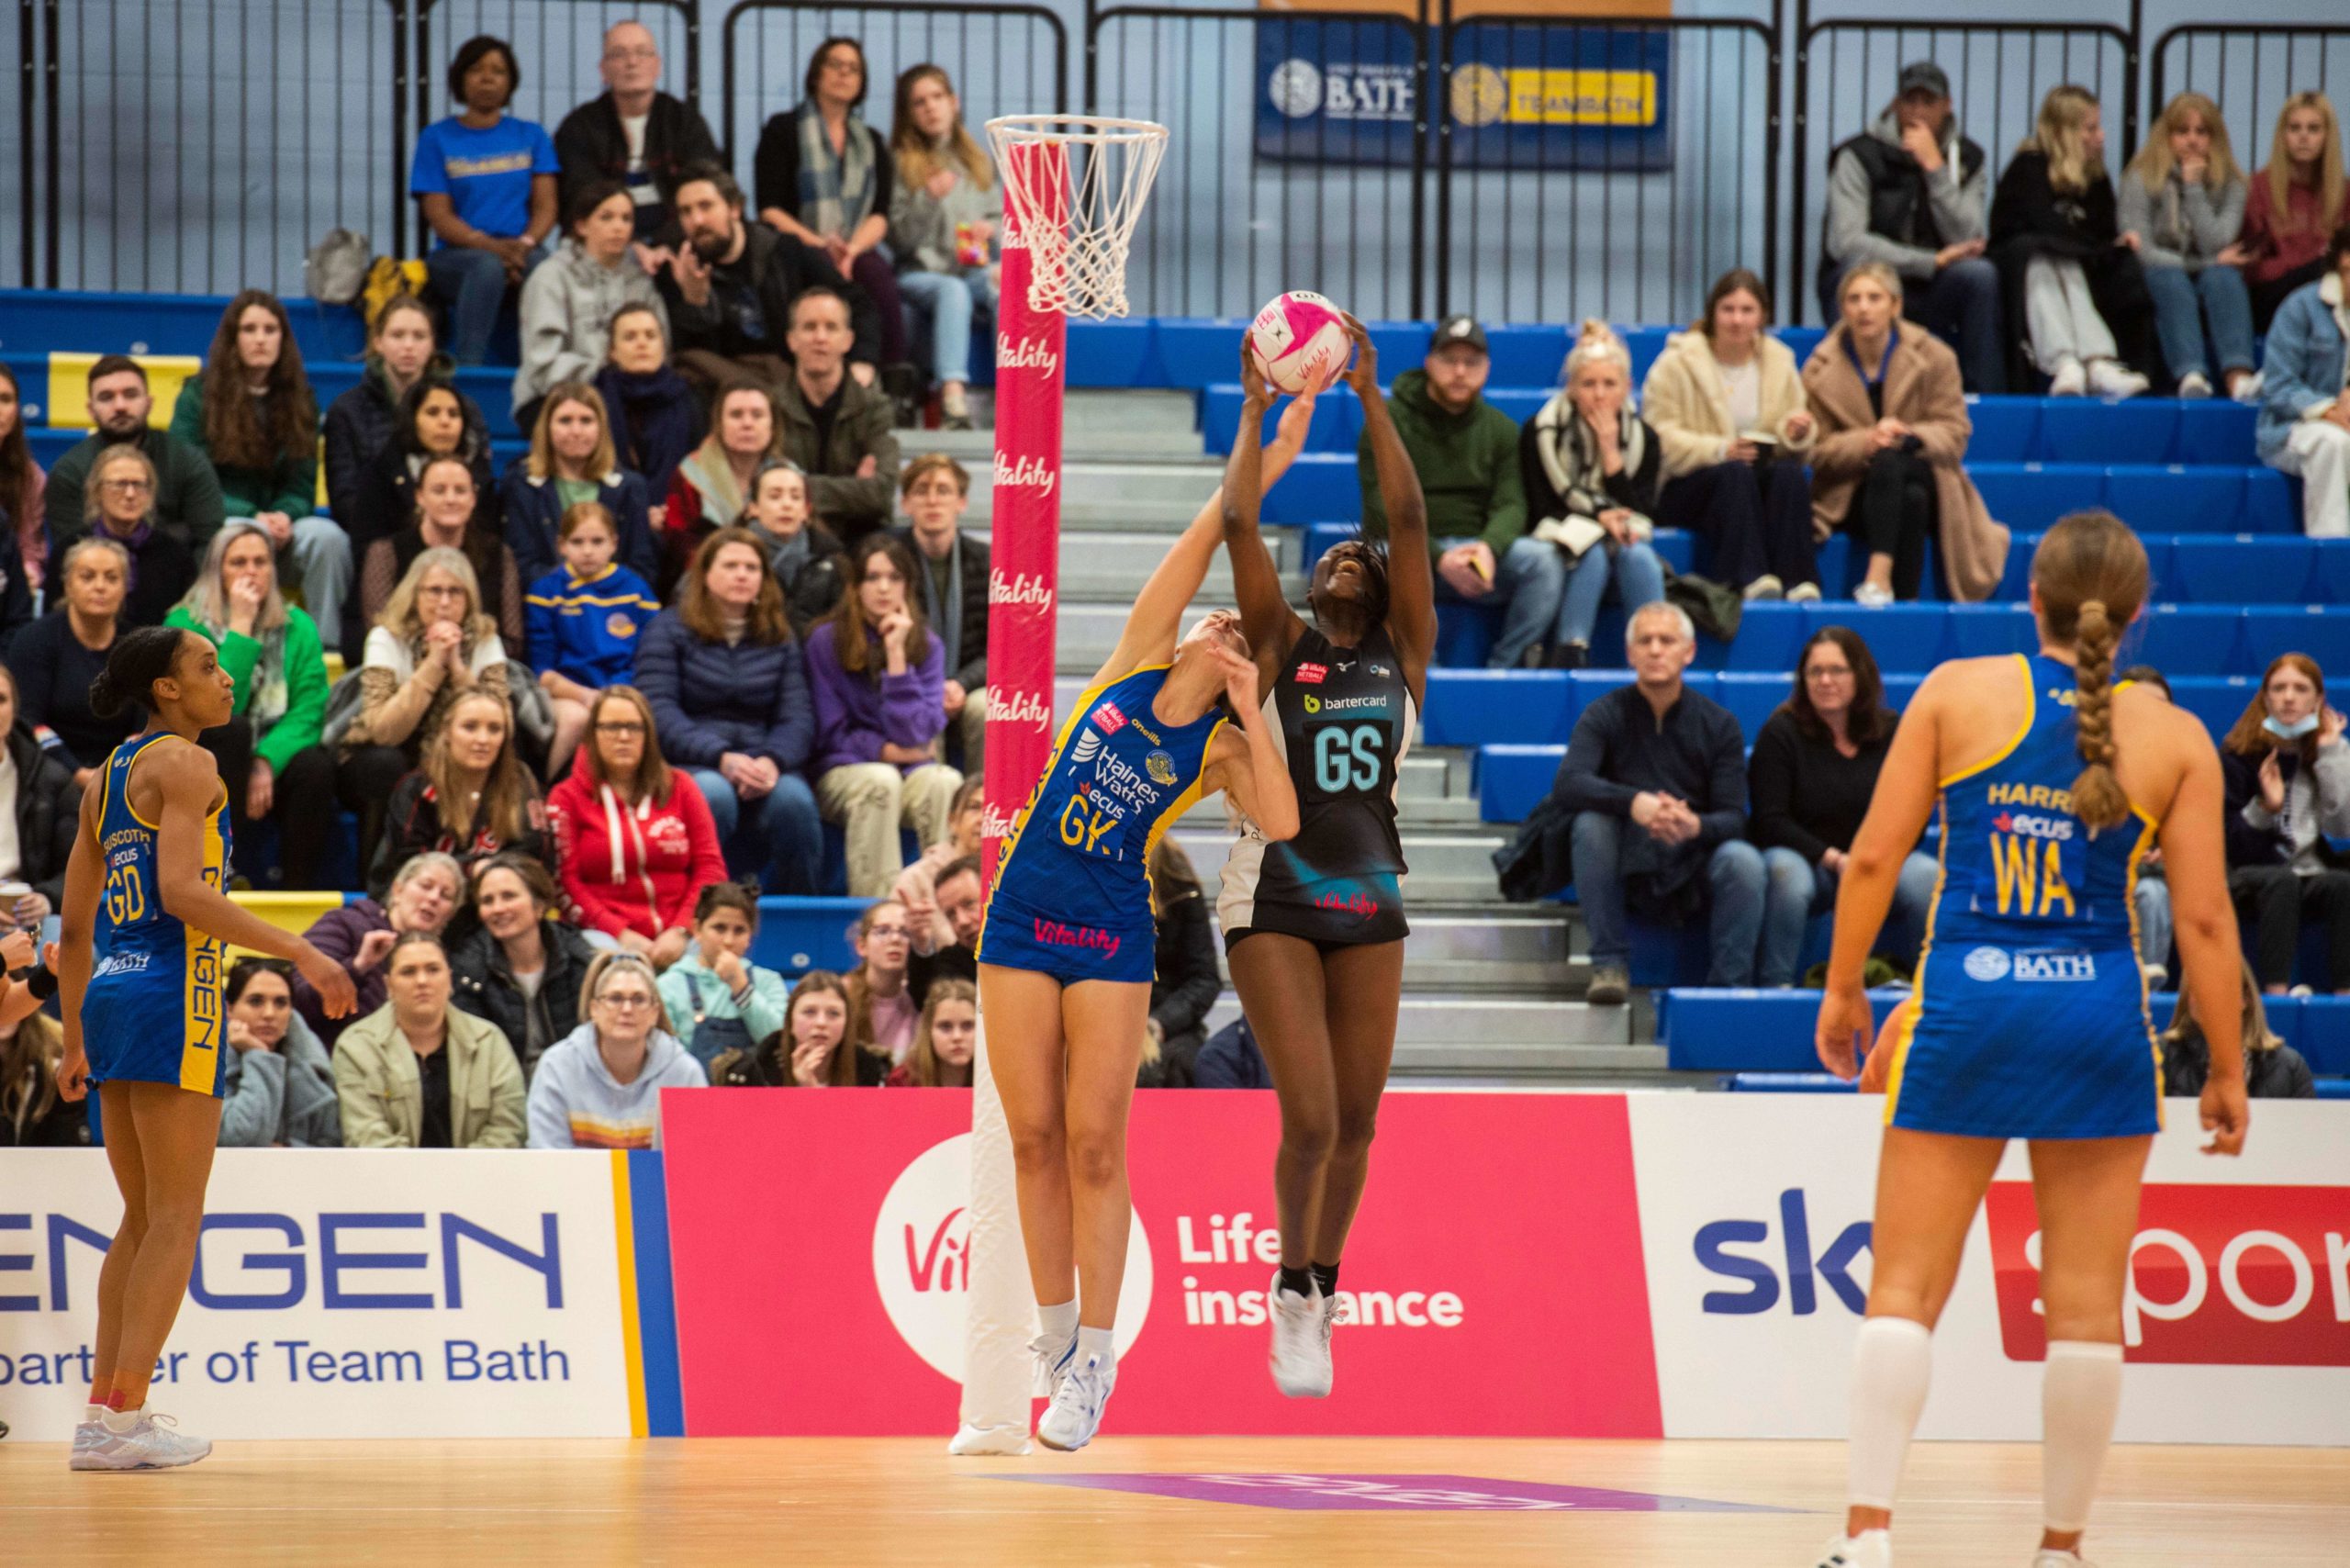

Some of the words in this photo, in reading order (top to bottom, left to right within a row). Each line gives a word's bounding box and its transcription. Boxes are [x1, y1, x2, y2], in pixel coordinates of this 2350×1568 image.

[1325, 696, 1387, 710] bartercard
[1098, 745, 1160, 804] Haines
[1315, 724, 1383, 793] GS
[1089, 789, 1126, 820] ecus
[1094, 761, 1145, 815] Watts
[1987, 783, 2075, 814] HARR
[1059, 794, 1119, 856] GK
[2012, 813, 2074, 840] ecus
[114, 847, 139, 867] ecus
[1988, 832, 2076, 917] WA
[106, 865, 145, 926] GD
[1034, 917, 1121, 960] Vitality
[2014, 954, 2096, 978] BATH
[1177, 1212, 1282, 1263] Life
[1693, 1188, 1874, 1316] sk
[1182, 1275, 1464, 1327] insance
[206, 1341, 259, 1383] of
[274, 1341, 422, 1383] Team
[444, 1339, 570, 1382] Bath
